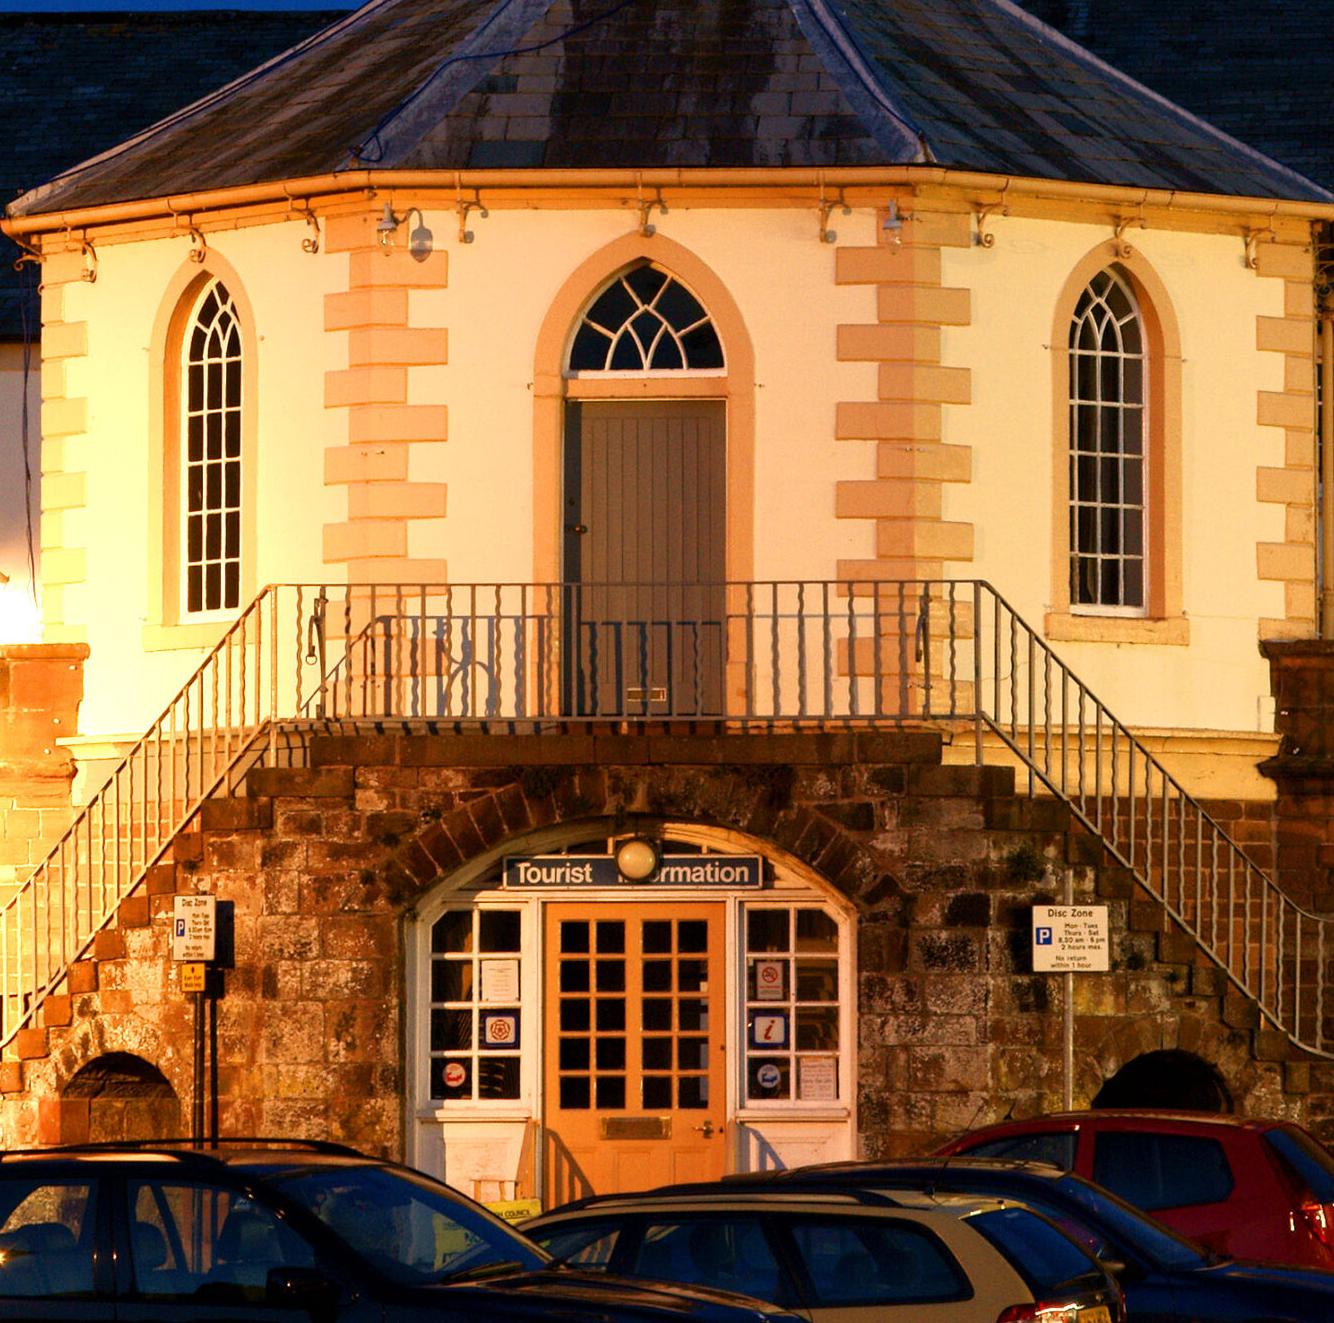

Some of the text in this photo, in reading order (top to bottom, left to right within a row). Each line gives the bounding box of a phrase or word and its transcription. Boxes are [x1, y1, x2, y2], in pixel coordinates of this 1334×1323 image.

[517, 862, 593, 883] Tourist
[1048, 909, 1093, 918] Disc Zone
[178, 920, 184, 936] P
[1039, 929, 1050, 944] P
